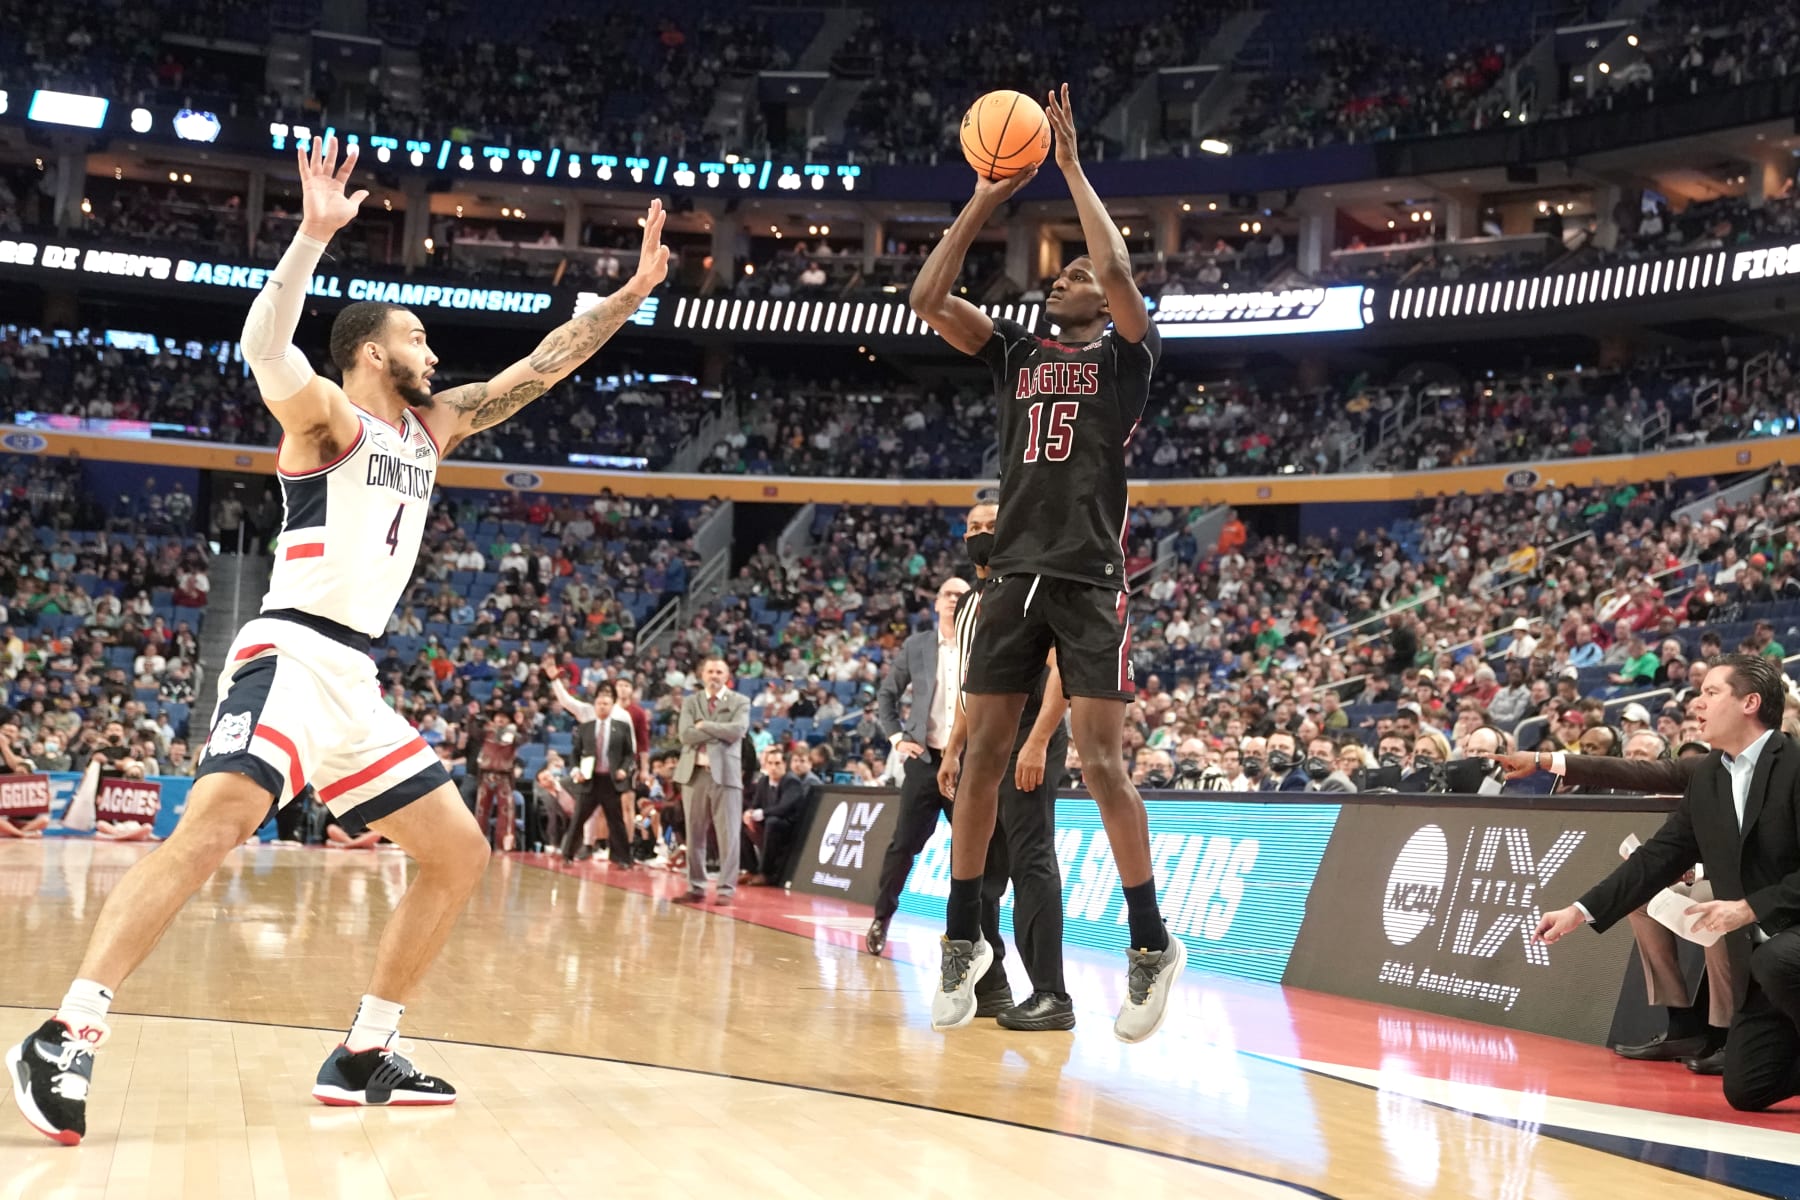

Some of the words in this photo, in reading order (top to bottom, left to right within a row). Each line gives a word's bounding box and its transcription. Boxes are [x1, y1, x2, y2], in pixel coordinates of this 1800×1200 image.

[83, 250, 172, 280] MEN'S
[175, 260, 342, 298] BASKEALL
[347, 278, 551, 314] CHAMPIONSHIP
[1023, 401, 1080, 463] 15
[366, 453, 433, 501] CONNCTICUT
[385, 502, 405, 557] 4
[100, 786, 159, 817] AGGIES
[1116, 832, 1259, 941] EARS
[1470, 878, 1536, 908] TITLE
[1379, 960, 1414, 987] 50th
[1417, 966, 1521, 1012] Anniversary
